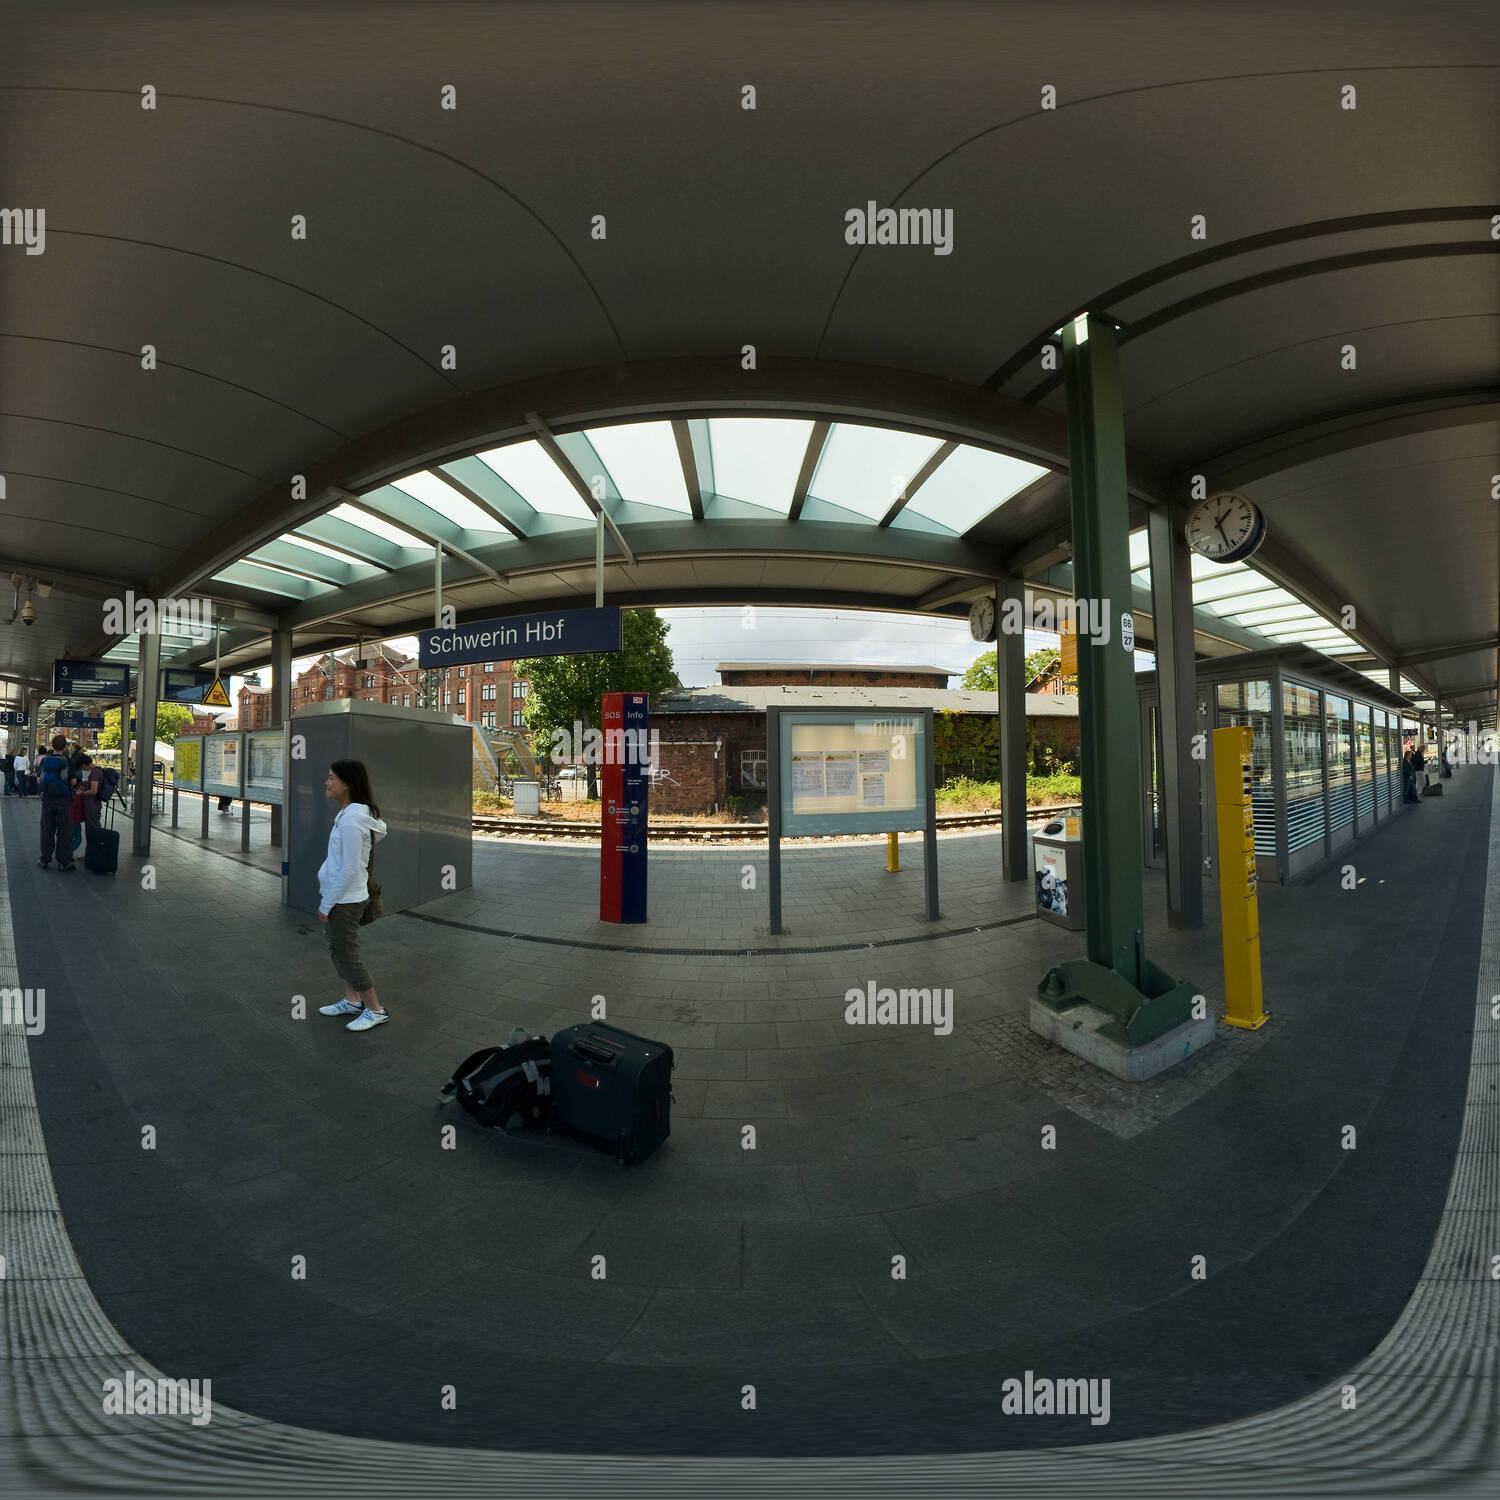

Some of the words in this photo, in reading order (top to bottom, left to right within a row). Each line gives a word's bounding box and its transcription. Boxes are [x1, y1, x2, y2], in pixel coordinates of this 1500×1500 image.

[1123, 618, 1132, 629] 66
[429, 626, 518, 655] Schwerin
[525, 618, 565, 643] Hbf
[1124, 635, 1133, 646] 27
[61, 666, 68, 676] 3
[16, 712, 24, 723] B
[604, 711, 621, 719] SOS
[627, 711, 644, 719] Info
